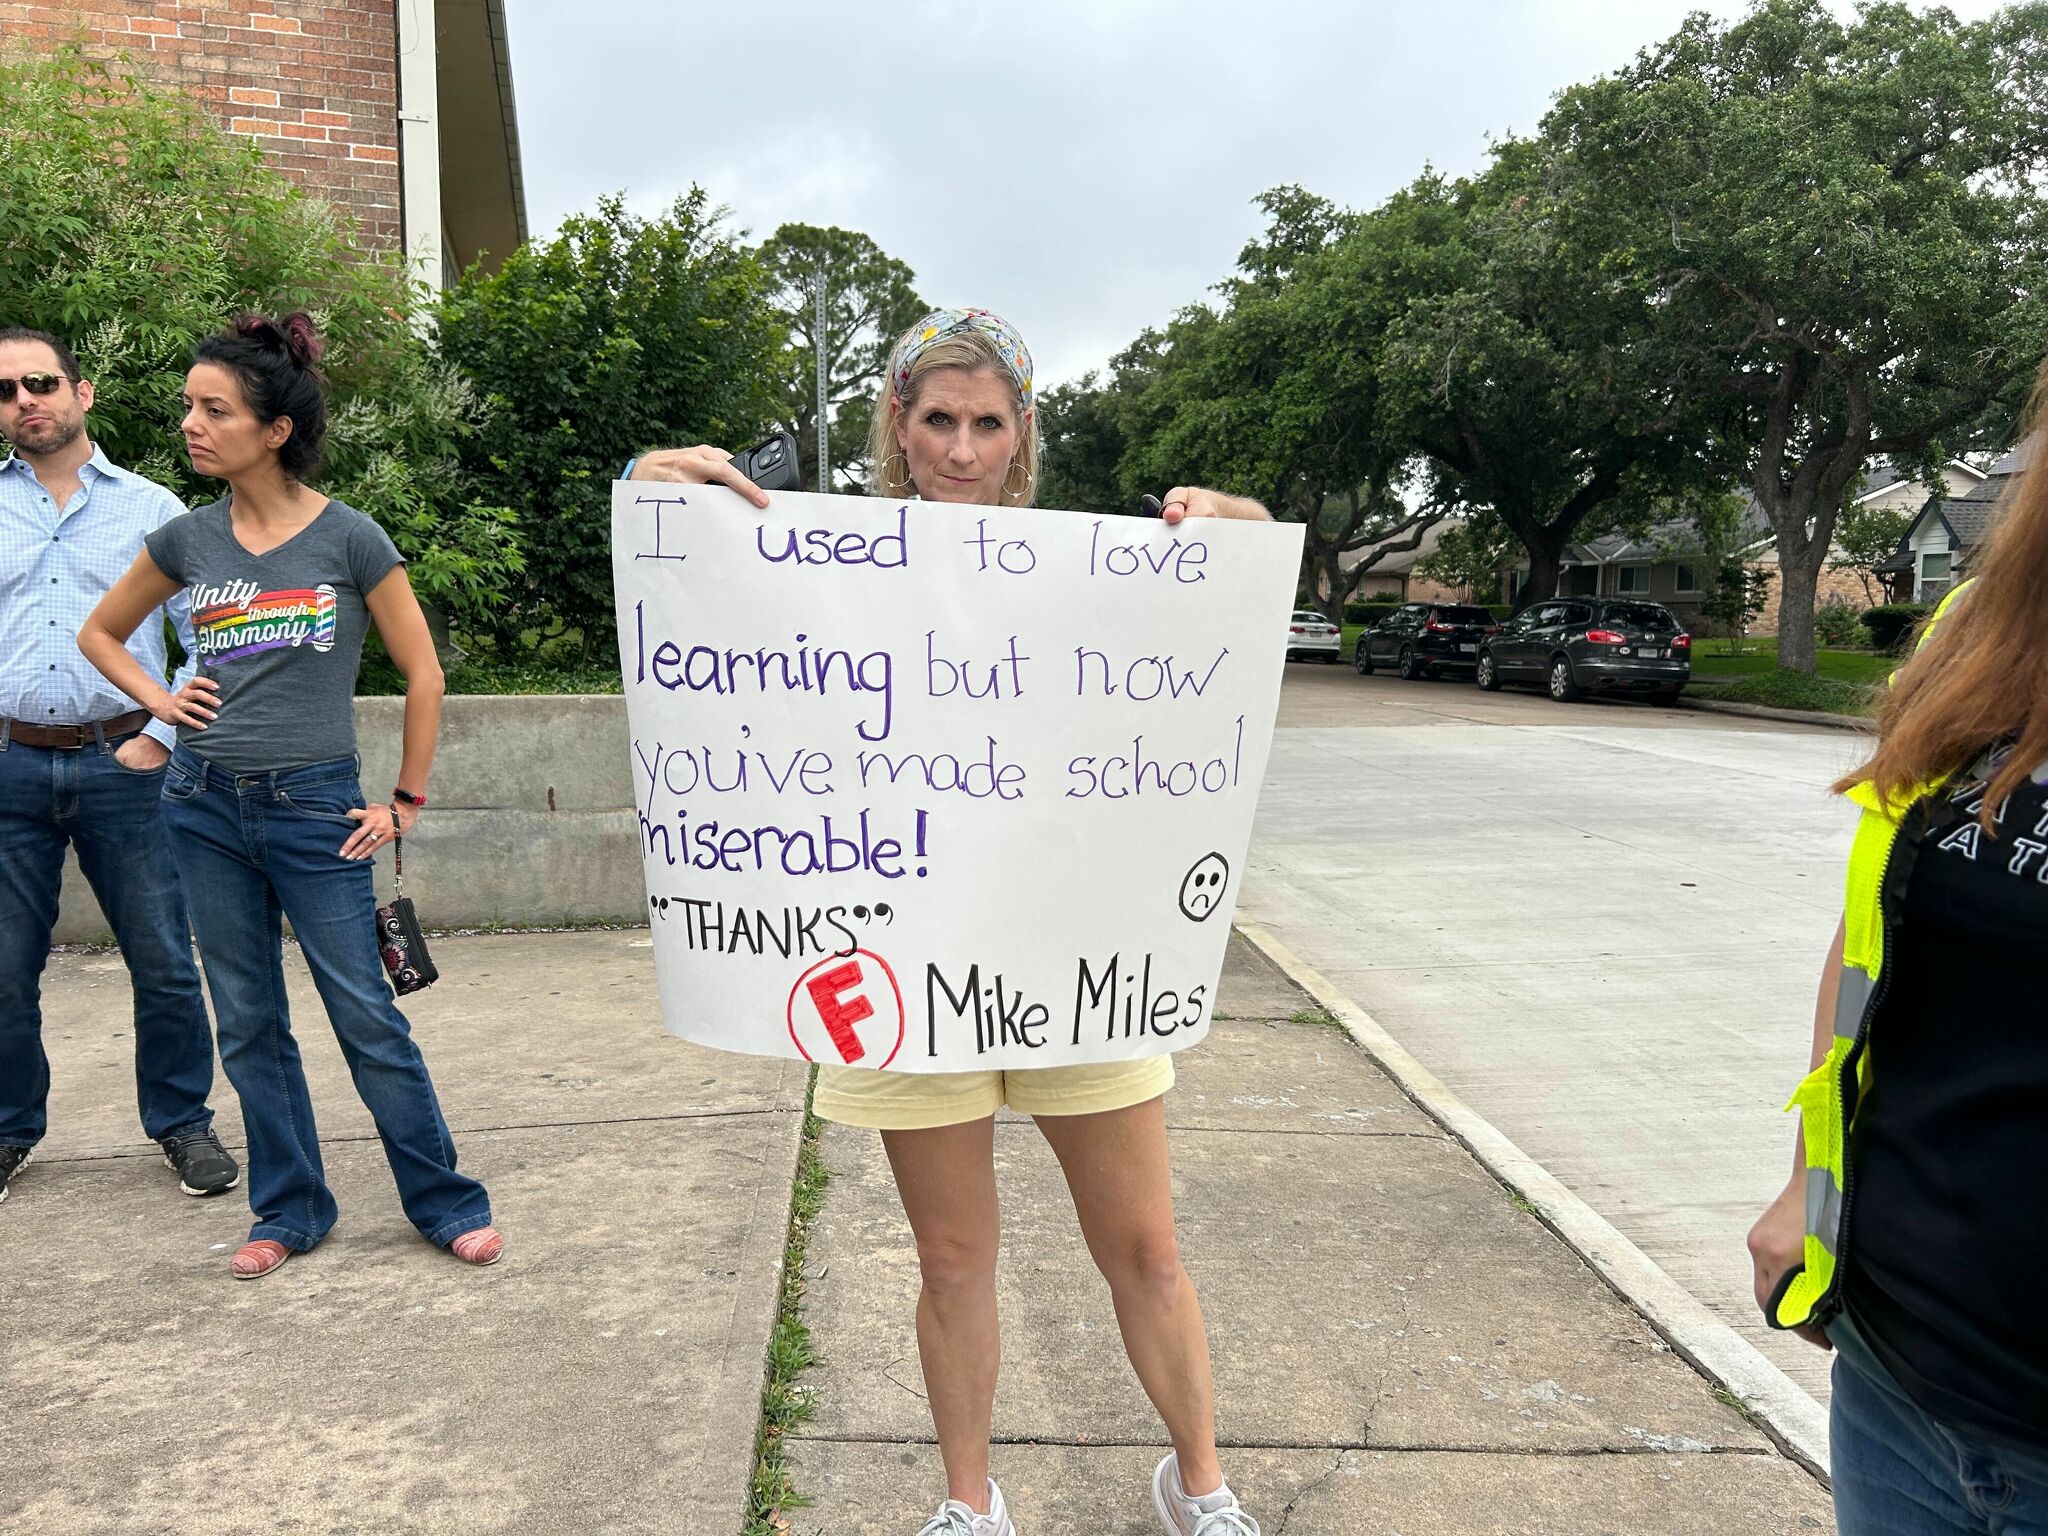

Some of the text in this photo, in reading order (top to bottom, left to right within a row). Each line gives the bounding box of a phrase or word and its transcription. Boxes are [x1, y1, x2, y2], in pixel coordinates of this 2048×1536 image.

[635, 496, 1208, 583] I used to love
[191, 578, 261, 613] Unity
[199, 620, 311, 655] Harmony
[248, 601, 310, 622] through
[635, 600, 1229, 741] learning but now
[634, 715, 1245, 819] you've made school
[639, 808, 929, 879] miserable!
[806, 960, 875, 1065] F
[926, 951, 1207, 1057] Mike Miles
